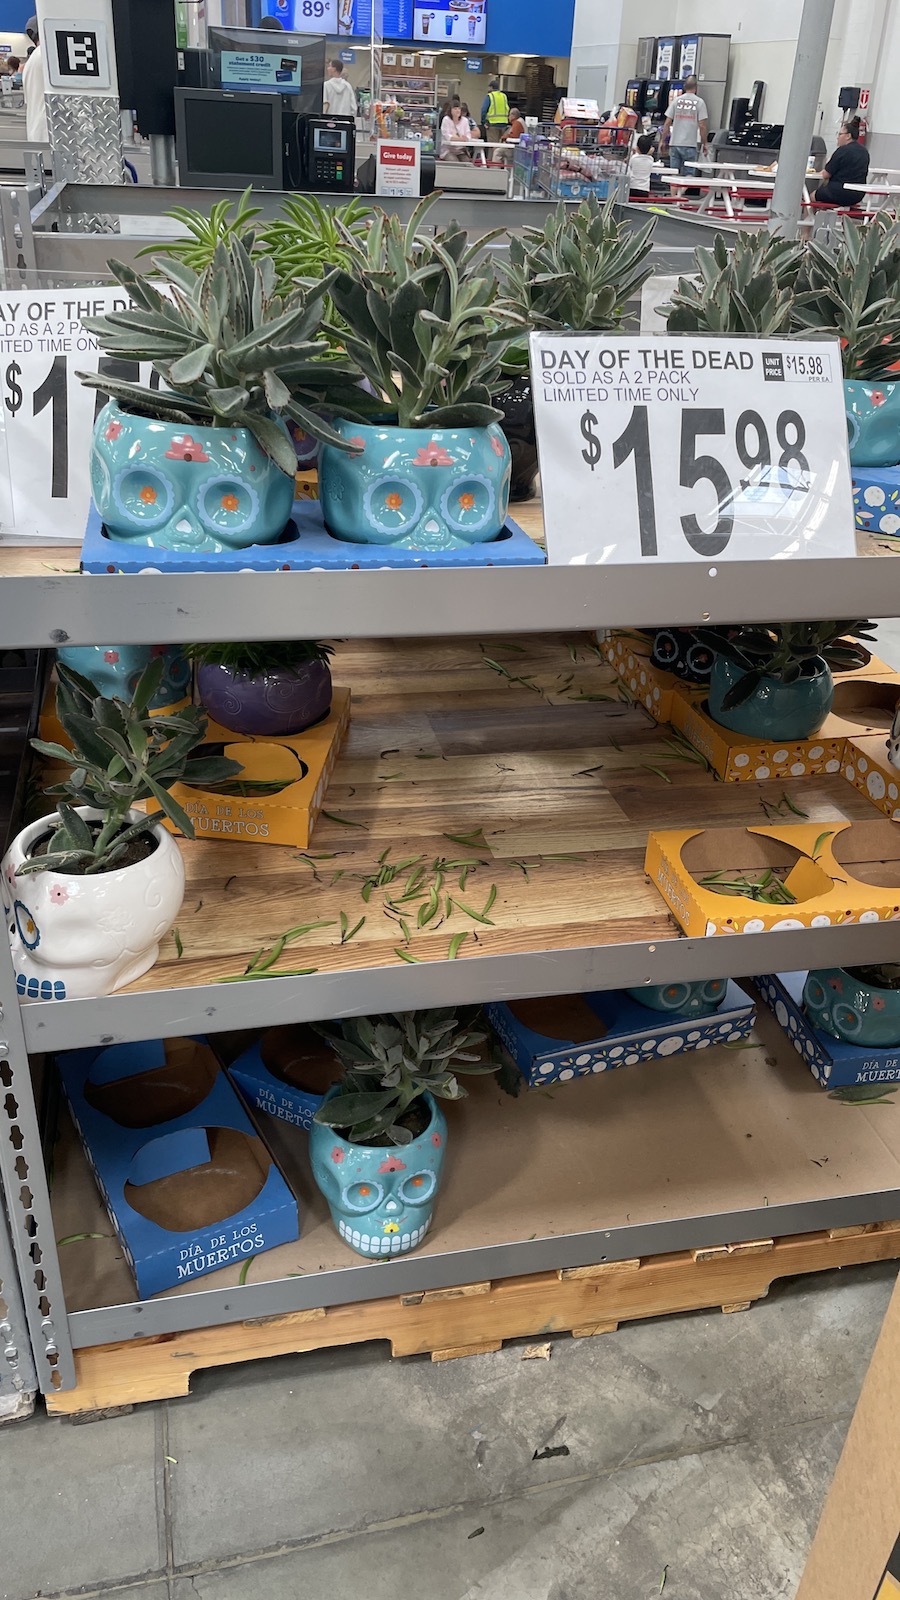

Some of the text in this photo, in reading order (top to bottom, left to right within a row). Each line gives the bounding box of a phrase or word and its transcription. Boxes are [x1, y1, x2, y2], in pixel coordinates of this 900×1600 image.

[383, 151, 412, 162] Give today
[27, 302, 56, 321] OF
[19, 322, 39, 336] AS
[42, 322, 53, 335] A
[57, 321, 65, 335] 2
[37, 338, 72, 352] TIME
[540, 349, 754, 370] DAY OF THE DEAD
[765, 357, 780, 366] UNIT
[786, 354, 823, 375] $15.98
[542, 370, 691, 384] SOLD AS A 2 PACK
[765, 368, 783, 377] PRICE
[543, 387, 700, 402] LIMITED TIME ONLY
[216, 805, 232, 816] DE
[239, 807, 264, 819] LOS
[885, 1059, 899, 1068] DE
[259, 1088, 276, 1102] DÍA
[281, 1097, 294, 1110] DE
[255, 1096, 311, 1131] MUERTO
[180, 1223, 258, 1261] DÍA DE LOS
[176, 1233, 265, 1279] MUERTOS
